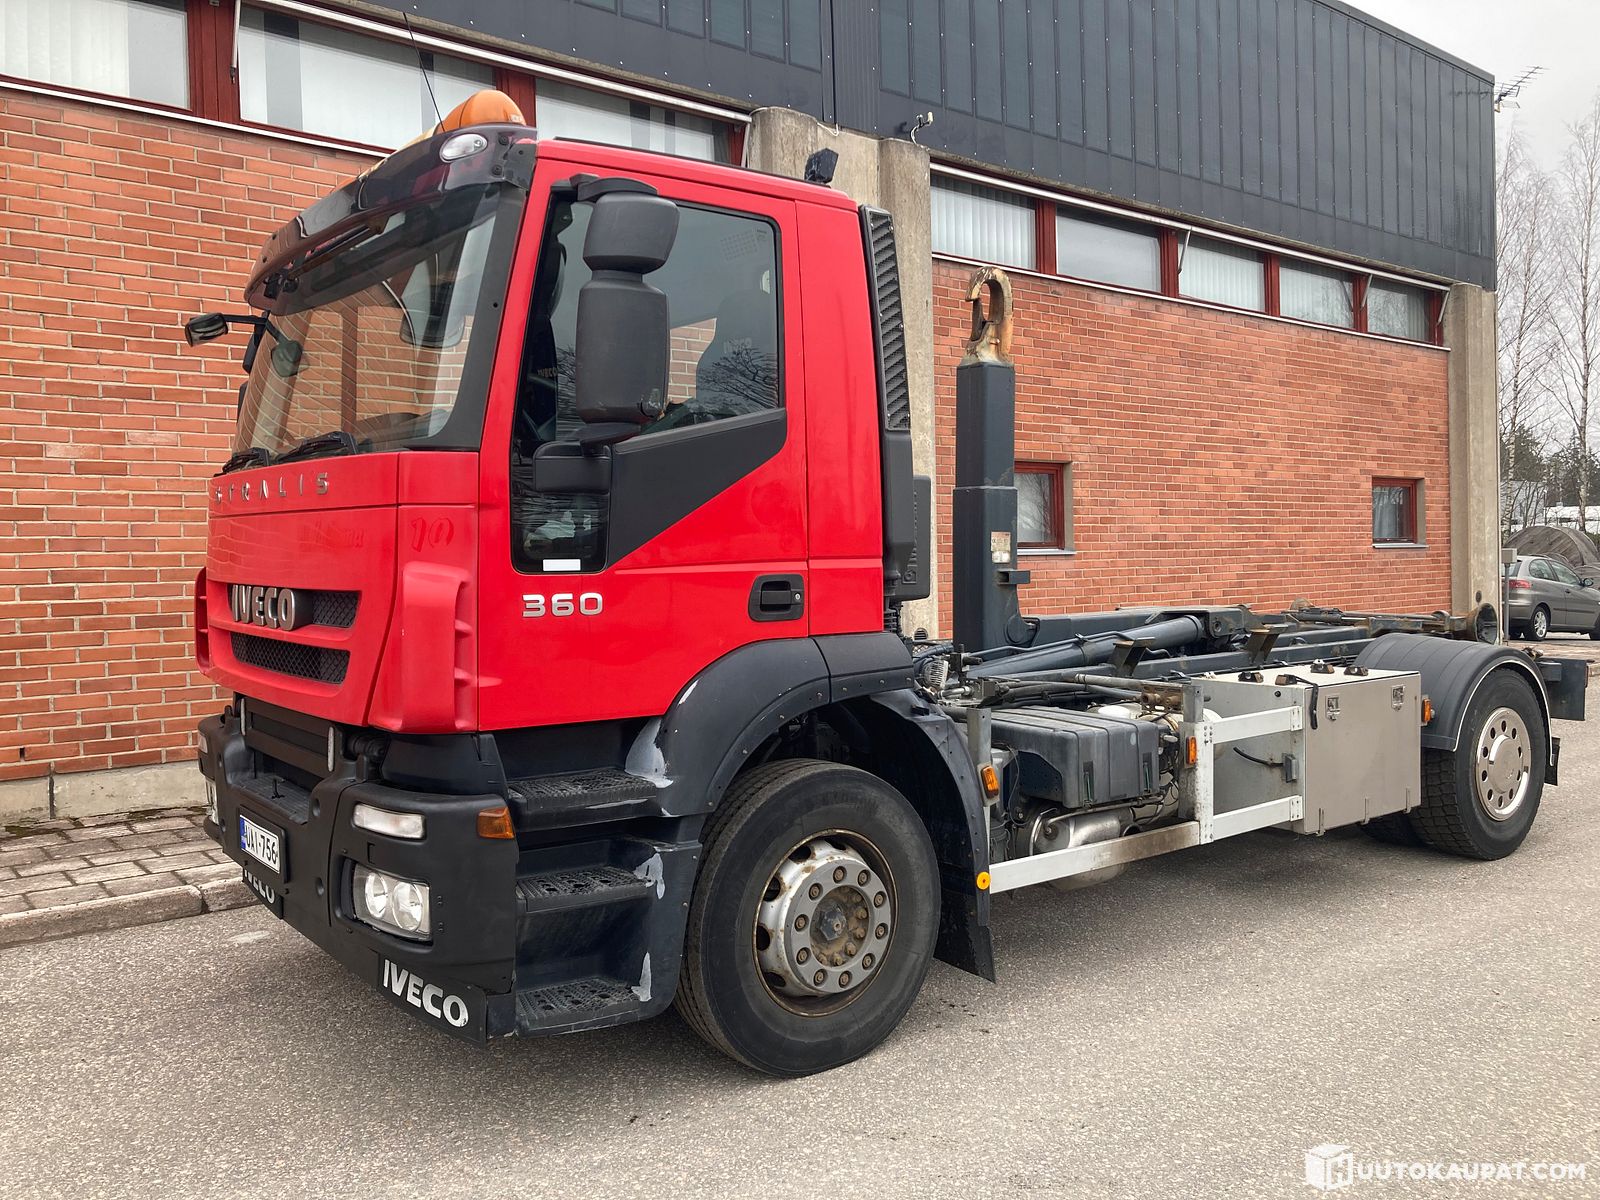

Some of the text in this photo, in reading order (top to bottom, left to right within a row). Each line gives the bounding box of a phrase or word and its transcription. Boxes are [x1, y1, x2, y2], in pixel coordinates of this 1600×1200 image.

[215, 472, 329, 504] STRALIS
[231, 584, 296, 632] IVECO
[522, 592, 603, 617] 360
[383, 959, 470, 1028] IVECO
